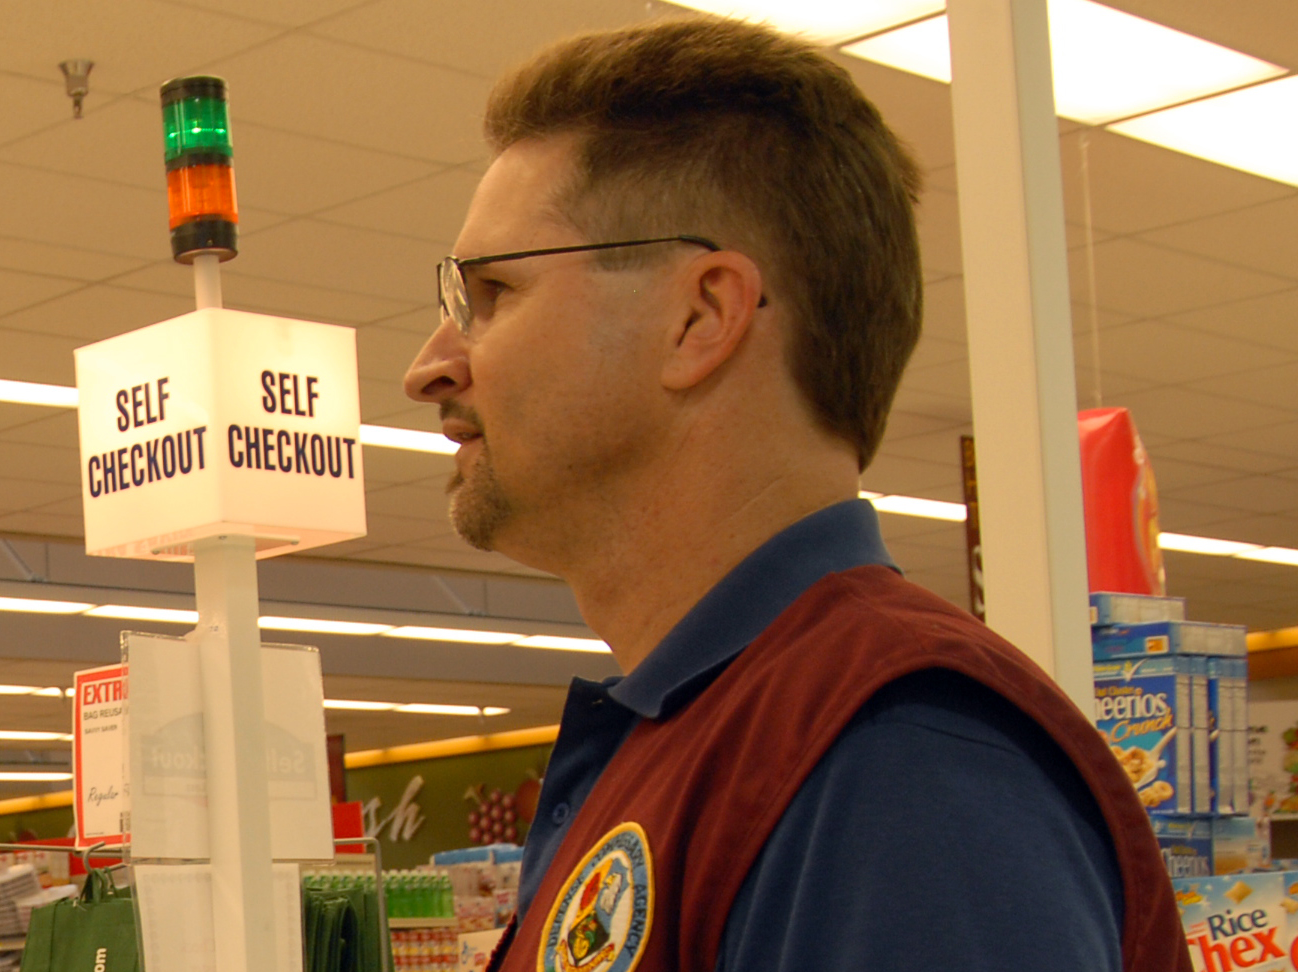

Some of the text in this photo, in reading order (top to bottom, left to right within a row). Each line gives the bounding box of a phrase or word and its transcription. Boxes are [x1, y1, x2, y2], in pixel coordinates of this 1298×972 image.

[115, 376, 169, 432] SELF
[260, 370, 319, 418] SELF
[87, 425, 207, 498] CHECKOUT
[228, 423, 356, 479] CHECKOUT
[1094, 690, 1168, 722] eerios
[1109, 706, 1174, 743] Crunch
[624, 884, 647, 958] AGENCY
[1207, 908, 1269, 941] Rice
